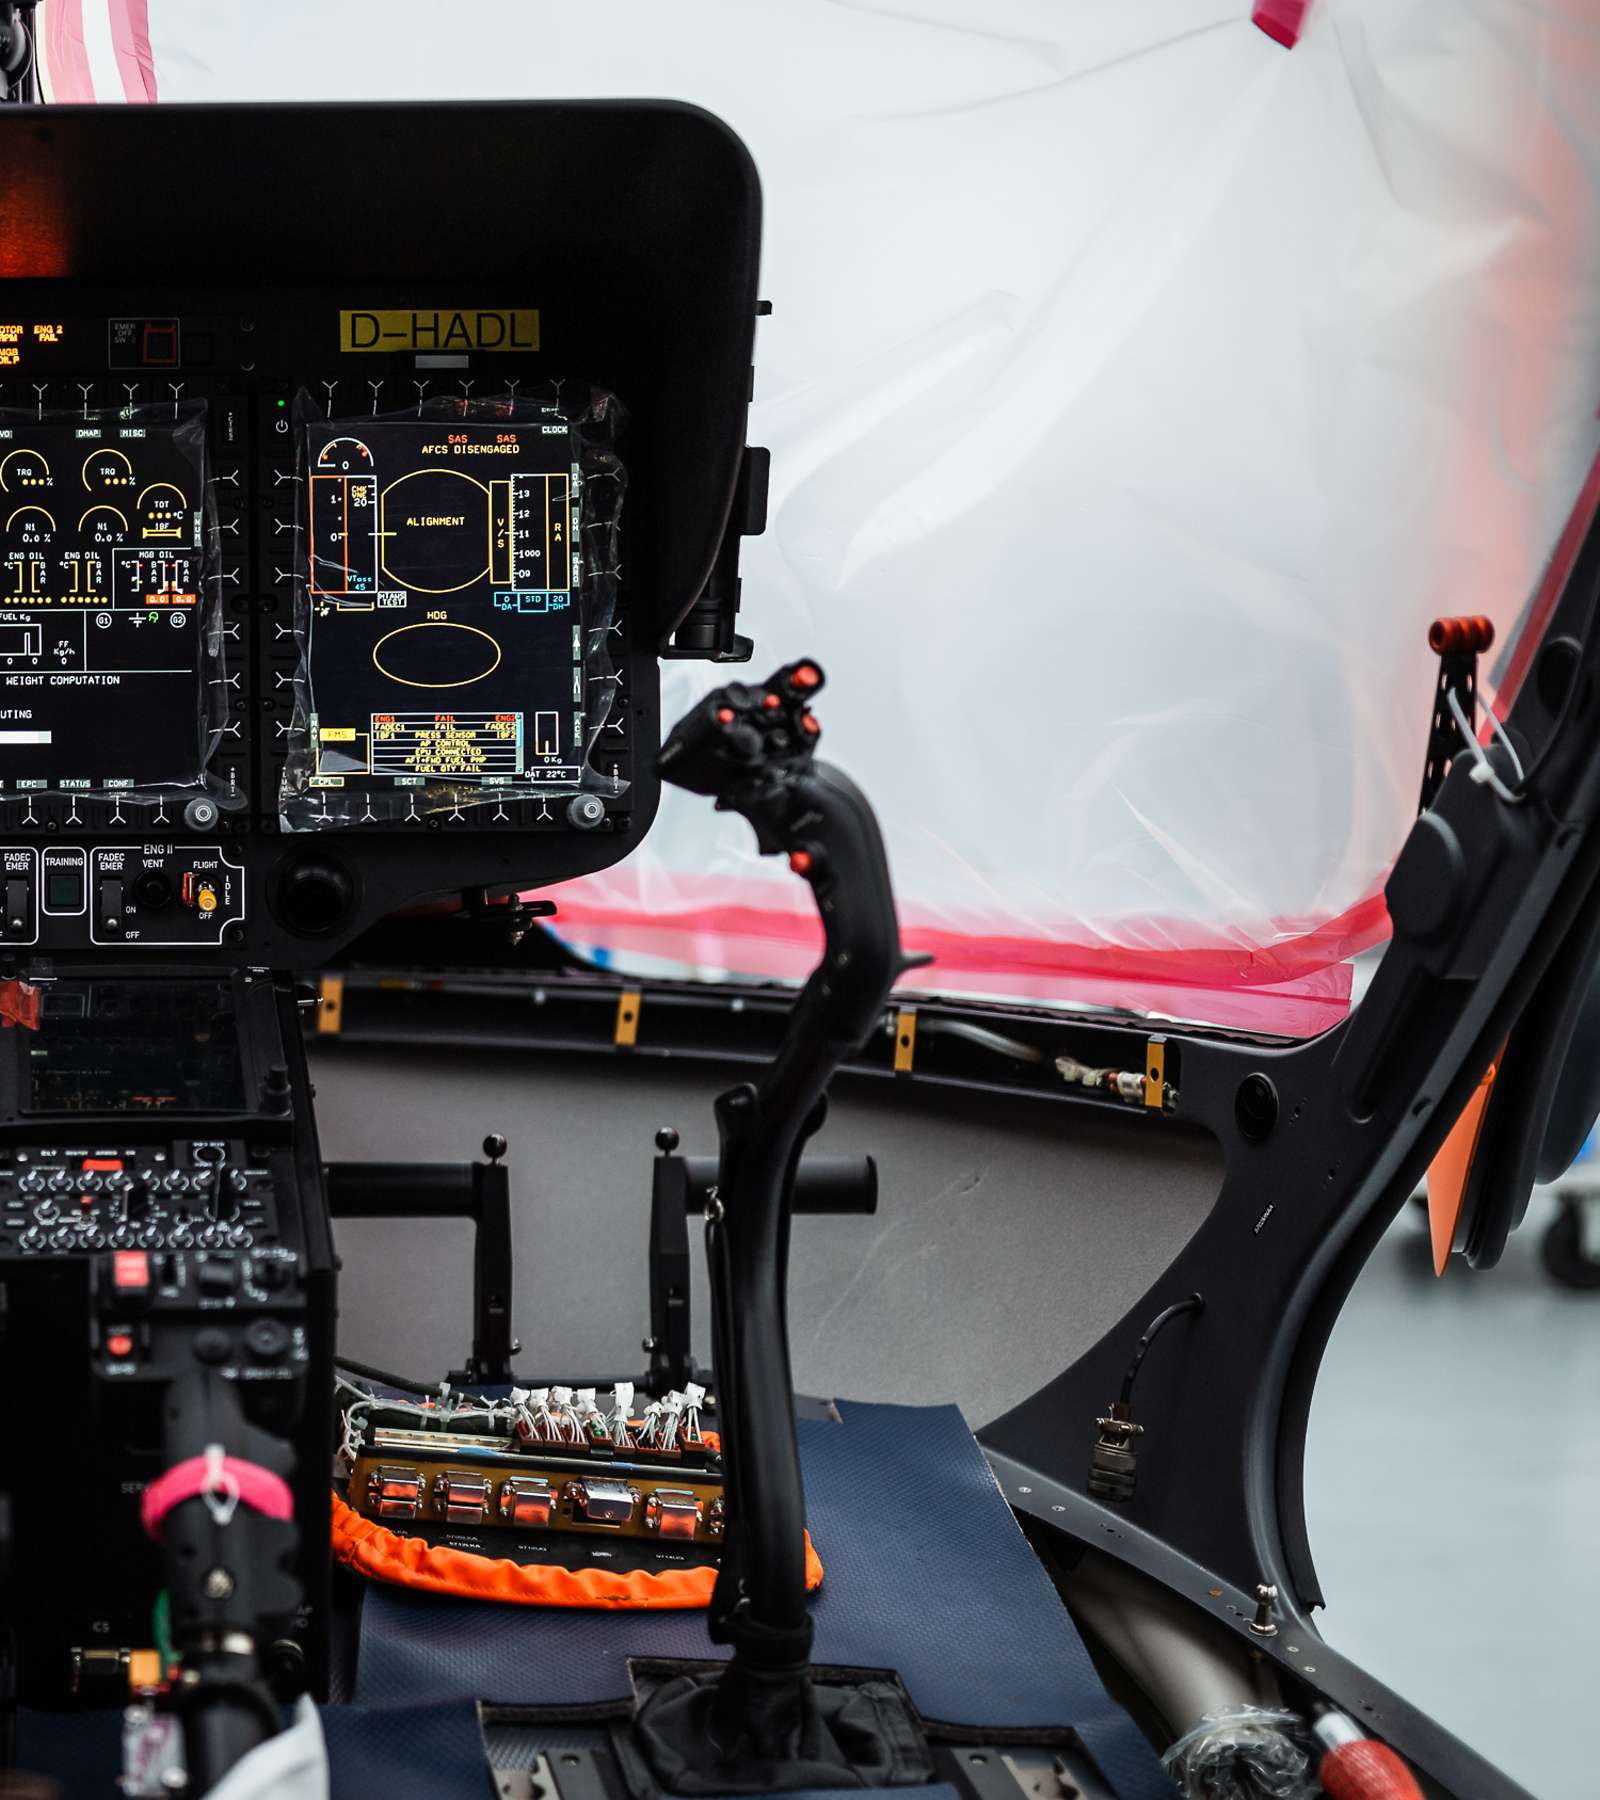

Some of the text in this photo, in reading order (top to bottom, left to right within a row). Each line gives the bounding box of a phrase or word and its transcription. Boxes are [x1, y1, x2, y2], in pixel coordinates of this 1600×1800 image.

[34, 325, 63, 336] ENG 2
[351, 313, 532, 348] D-HADL
[37, 332, 59, 341] FAIL
[10, 354, 19, 364] P
[448, 435, 467, 443] SAS
[497, 435, 516, 443] SAS
[422, 445, 519, 454] AFCS DISENGAGED
[519, 490, 529, 498] 13
[353, 497, 367, 506] 20
[519, 510, 530, 518] 12
[407, 517, 464, 526] ALIGNMENT
[519, 530, 529, 538] 11
[518, 550, 540, 558] 1000
[518, 570, 530, 578] 09
[20, 614, 30, 622] Kg
[427, 611, 447, 620] HDG
[54, 648, 75, 656] Kg/h
[6, 676, 44, 685] WEIGHT
[50, 676, 119, 685] COMPUTATION
[434, 713, 456, 723] FAIL
[434, 722, 456, 731] FAIL
[414, 730, 477, 740] PRESS SENSOR
[435, 739, 471, 748] CONTROL
[435, 747, 482, 756] CONNECTED
[444, 756, 467, 765] FUEL
[414, 764, 482, 772] FUEL FAIL
[525, 770, 540, 778] OAT
[143, 844, 173, 854] ENG II
[4, 853, 30, 861] FADEC
[98, 853, 125, 861] FADEC
[46, 857, 83, 866] TRAINING
[142, 860, 163, 868] VENT
[193, 861, 218, 869] FLIGHT
[6, 862, 29, 870] EMER
[100, 862, 123, 870] EMER
[126, 906, 136, 914] ON
[198, 912, 212, 920] OFF
[125, 931, 139, 939] OFF
